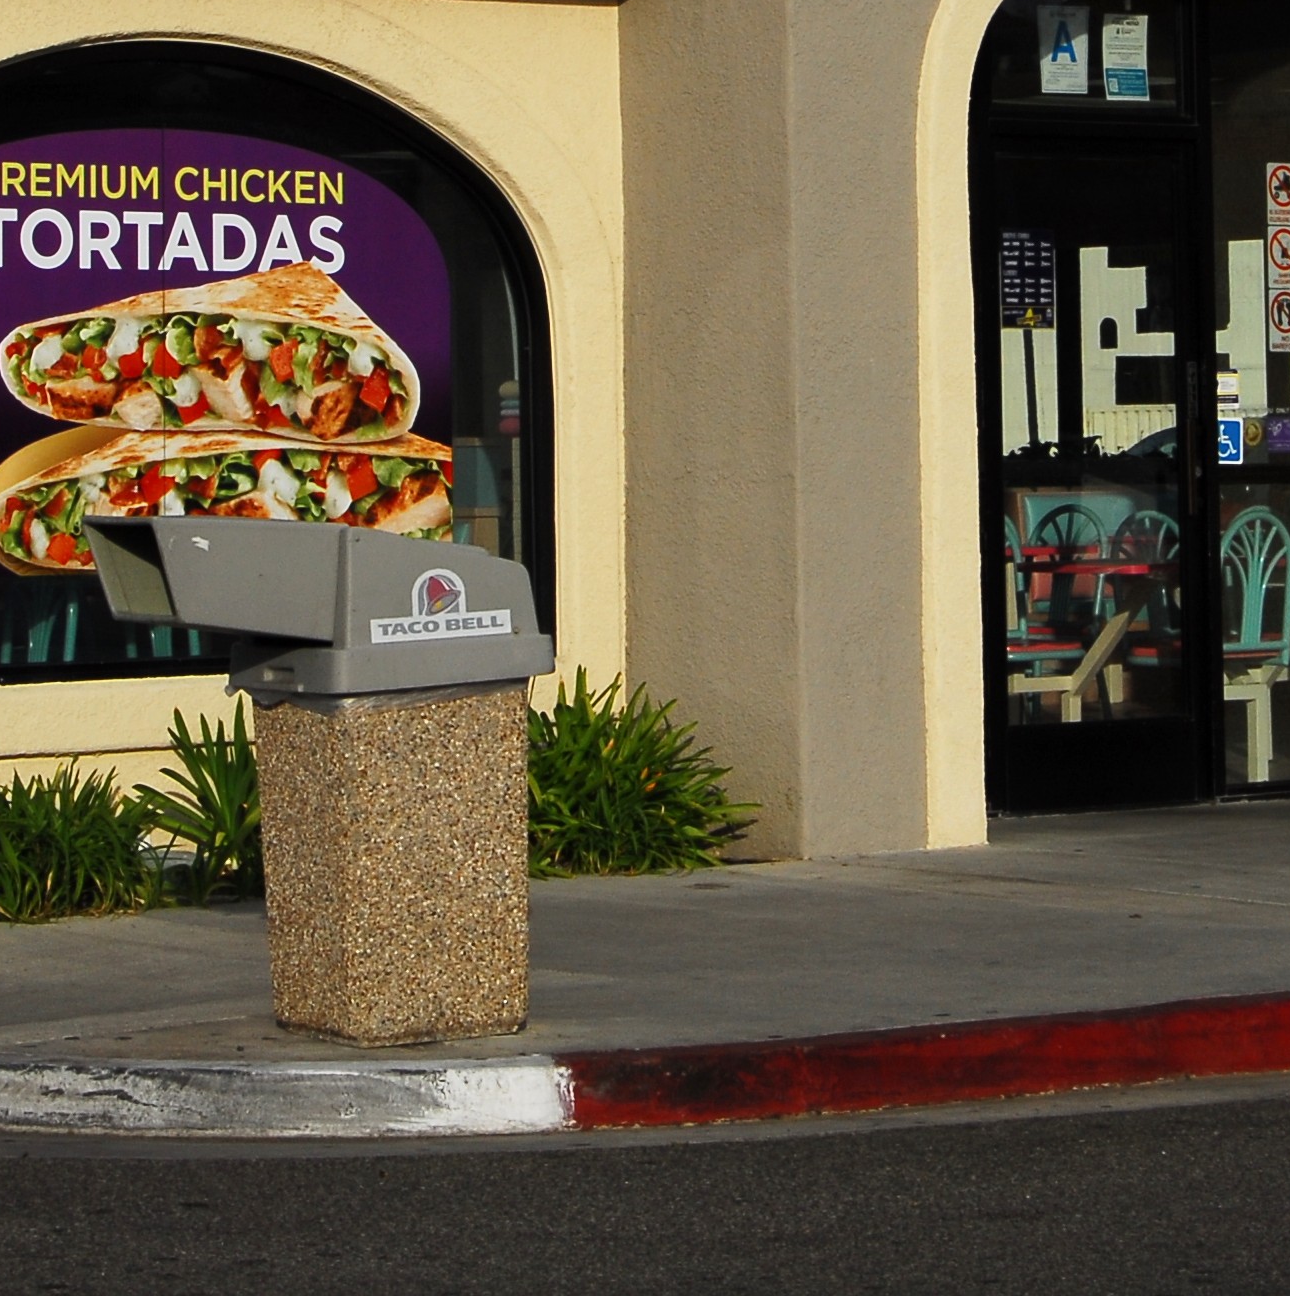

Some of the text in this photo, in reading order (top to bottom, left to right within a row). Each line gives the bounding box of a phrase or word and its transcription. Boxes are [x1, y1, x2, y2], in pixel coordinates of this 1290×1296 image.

[1051, 20, 1077, 63] A
[174, 167, 345, 206] CHICKEN
[378, 615, 504, 636] TACO BELL
